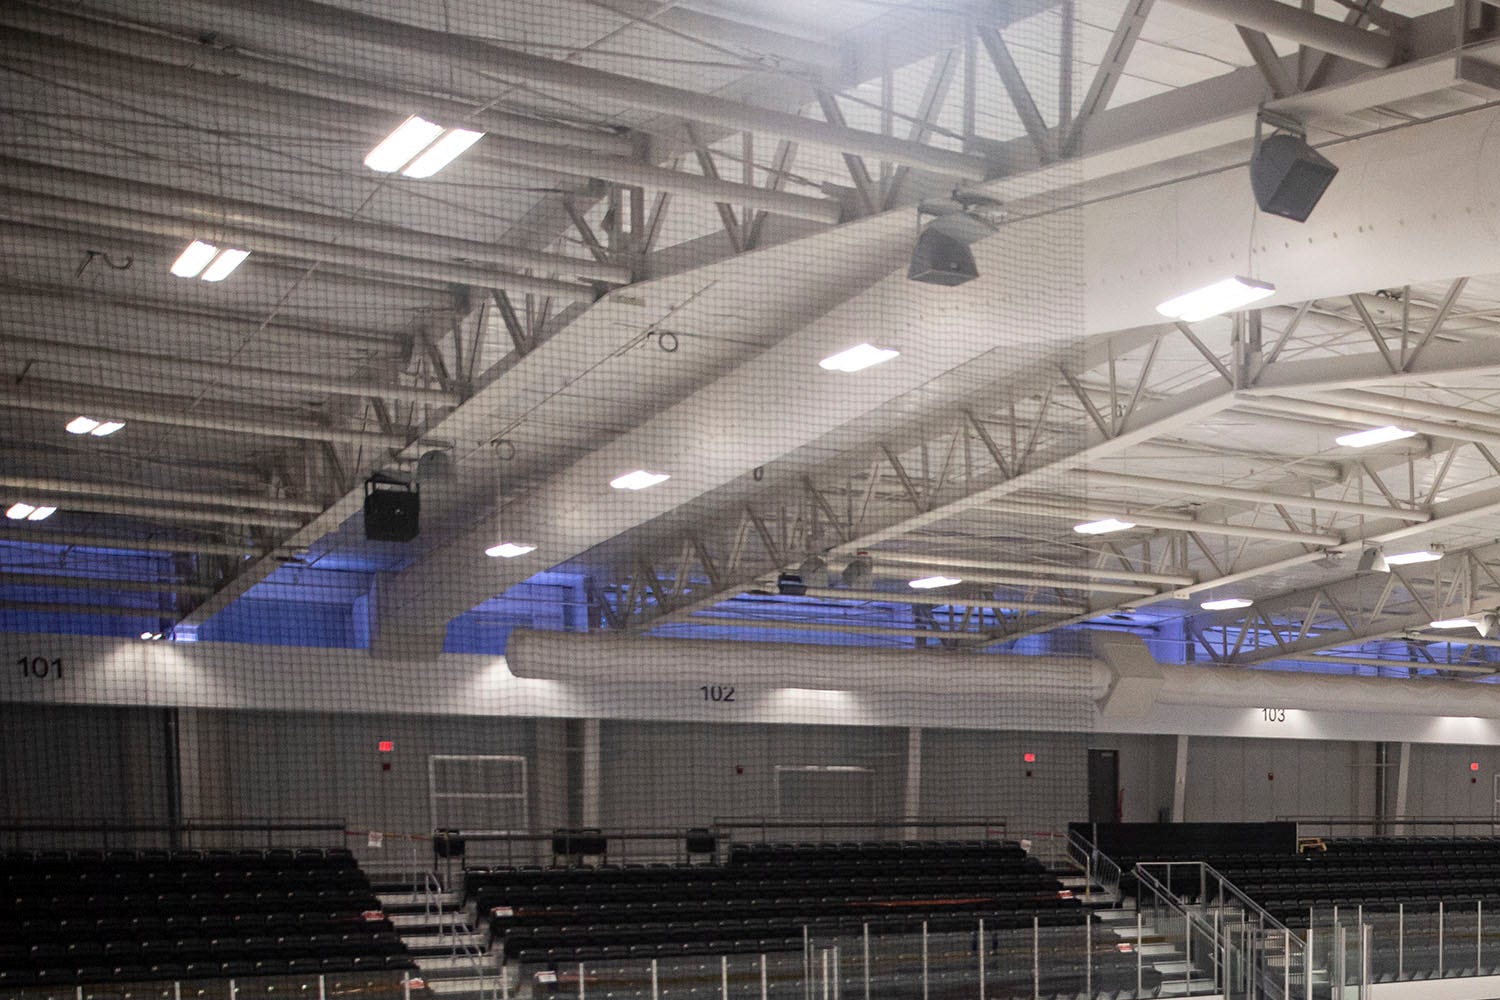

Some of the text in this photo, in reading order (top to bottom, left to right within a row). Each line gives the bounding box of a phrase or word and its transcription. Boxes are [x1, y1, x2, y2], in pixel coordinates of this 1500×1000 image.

[16, 656, 62, 678] 101
[700, 686, 735, 702] 102
[1261, 707, 1286, 722] 103
